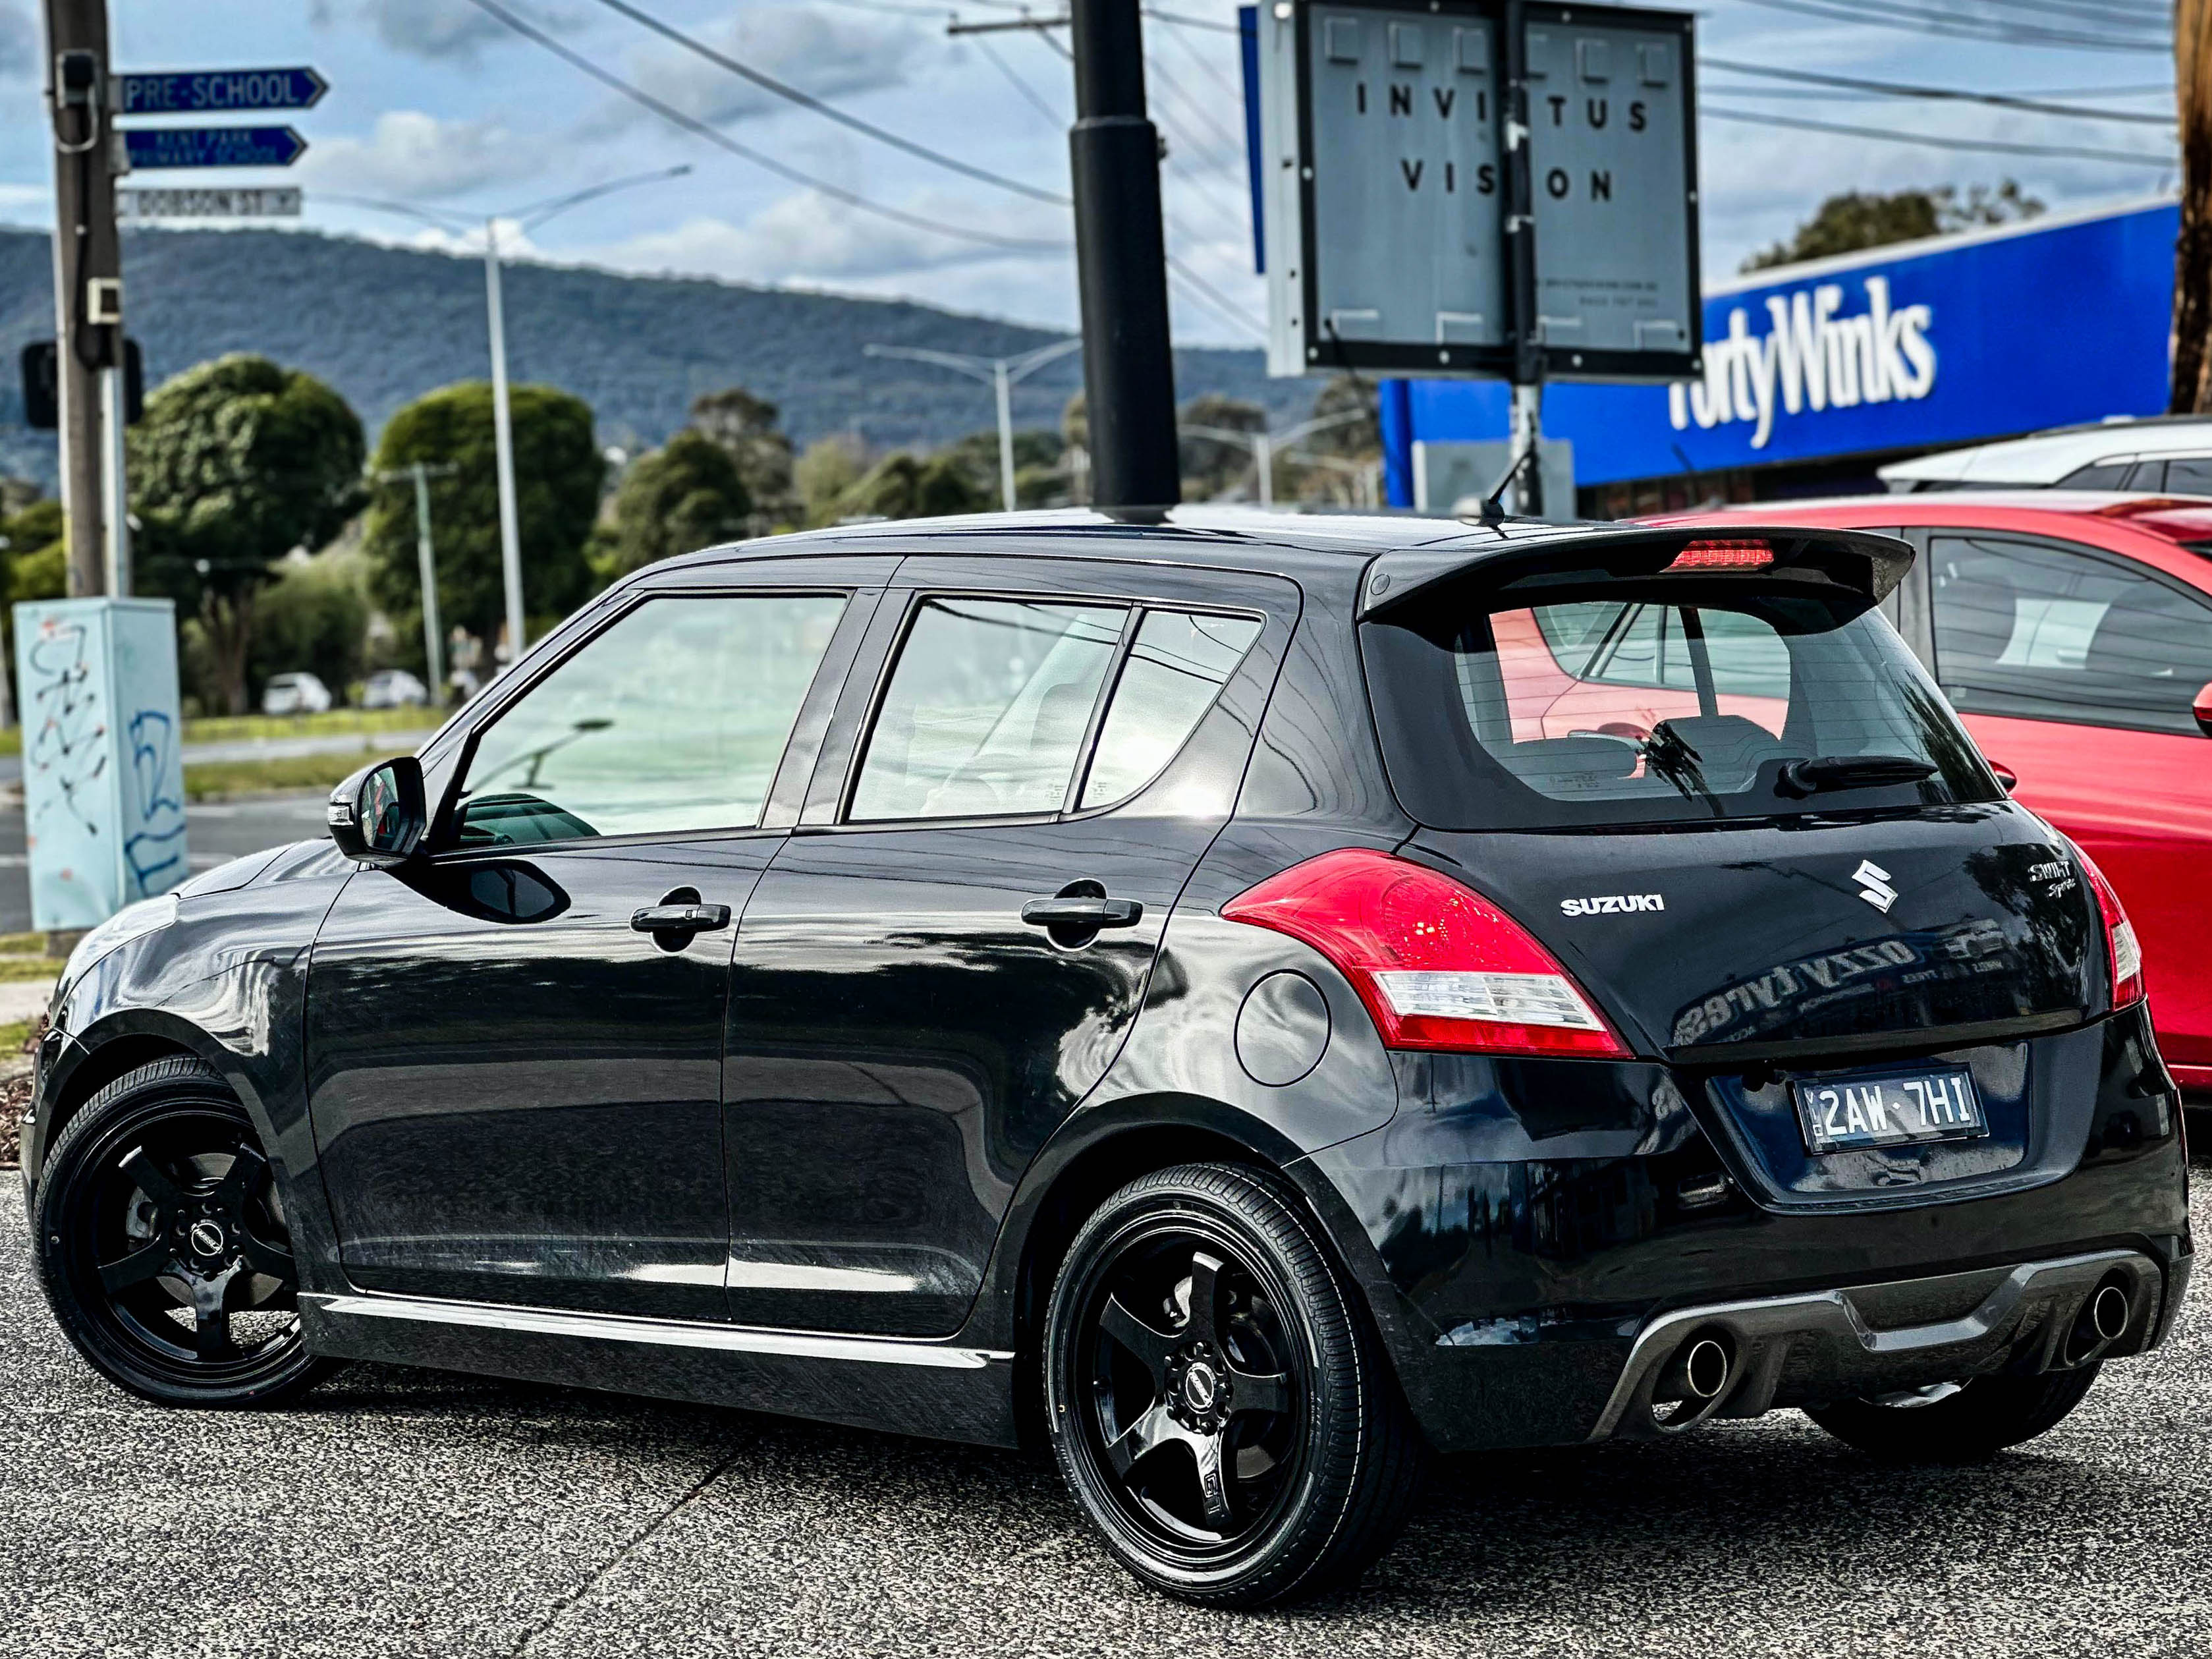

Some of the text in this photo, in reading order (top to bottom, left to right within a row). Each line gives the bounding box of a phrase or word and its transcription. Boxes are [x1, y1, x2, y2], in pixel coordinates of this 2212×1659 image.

[124, 73, 300, 110] PRE-SCHOOL
[1357, 82, 1647, 132] INVITUS
[1400, 158, 1611, 202] VISON
[1560, 893, 1665, 917] SUZUKI
